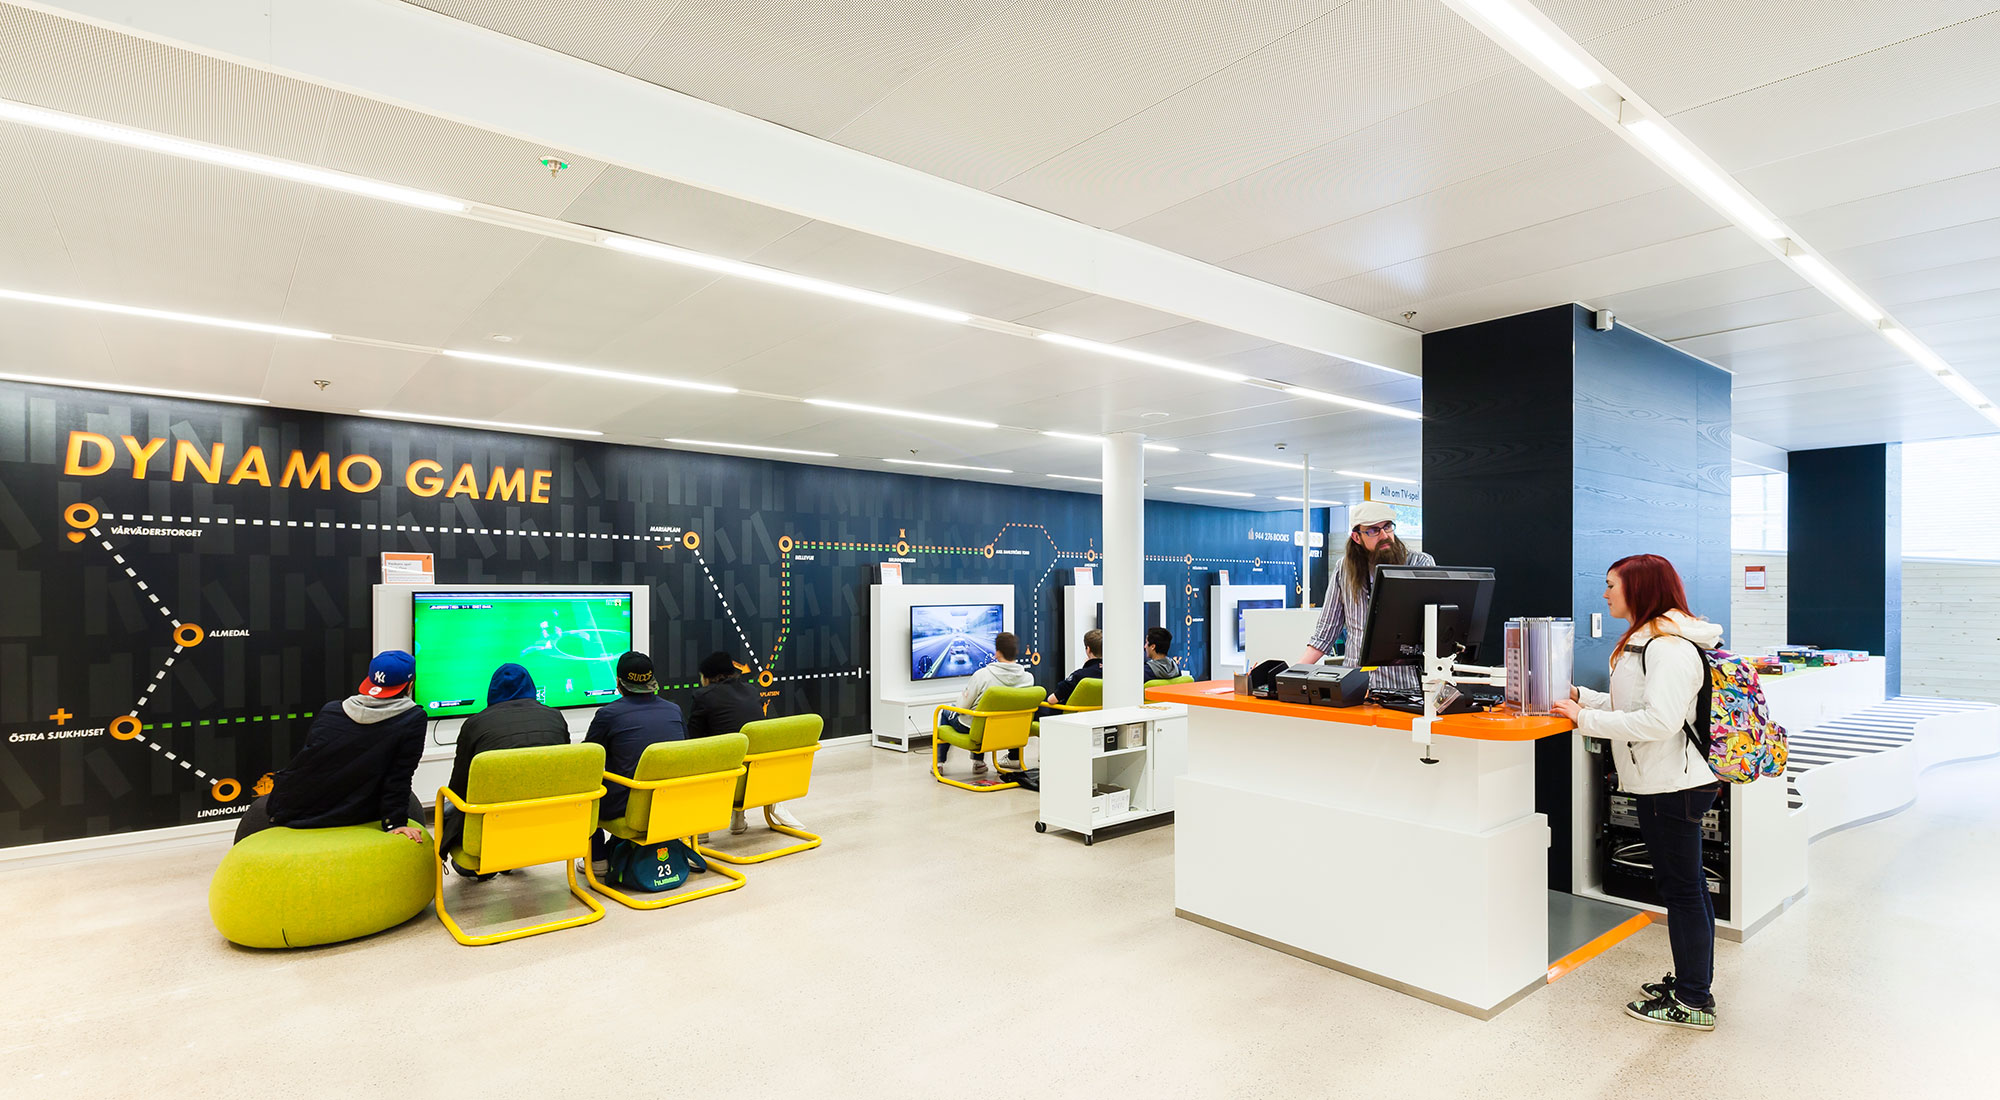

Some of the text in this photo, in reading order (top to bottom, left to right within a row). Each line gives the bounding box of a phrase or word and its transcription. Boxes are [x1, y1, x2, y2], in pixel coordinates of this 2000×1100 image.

[64, 430, 553, 504] DYNAMO GAME
[1381, 486, 1420, 502] Allt om TV-spel
[111, 526, 203, 538] VÅRVÄDERSTORGET
[1273, 533, 1290, 542] BOOKS
[1309, 550, 1320, 558] AYER
[209, 629, 251, 638] ALMEDAL
[9, 727, 106, 743] ÖSTRA SJUKHUSET
[657, 863, 672, 878] 23
